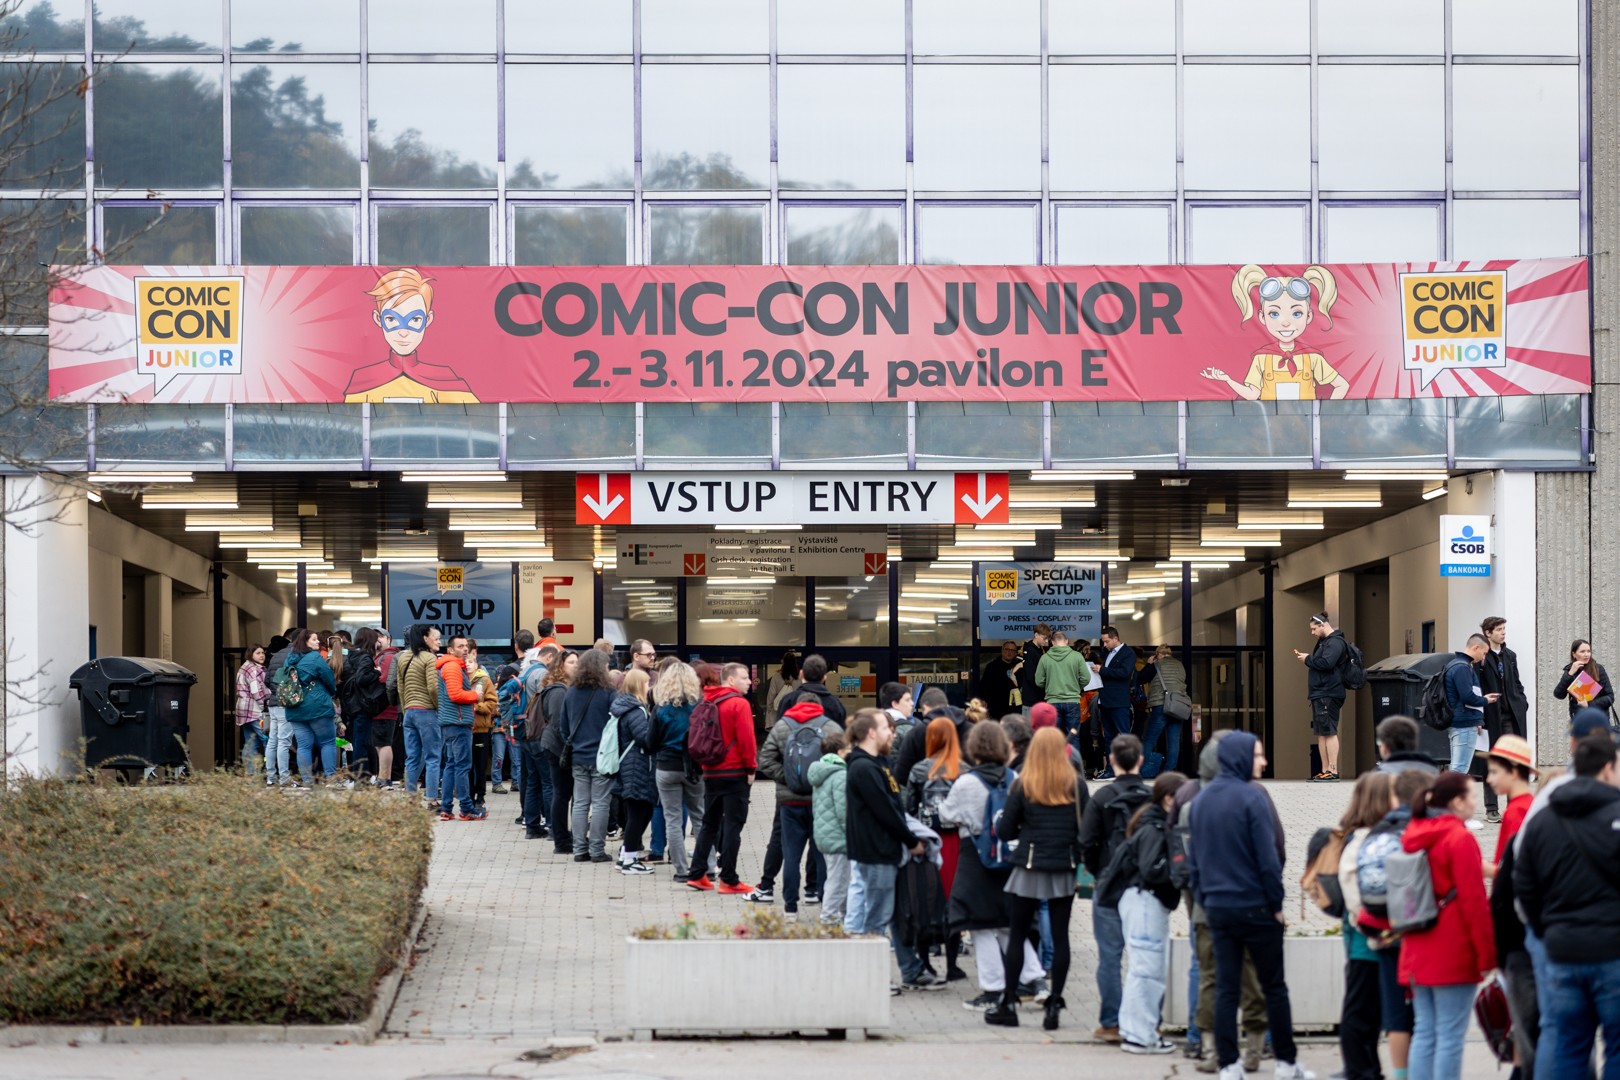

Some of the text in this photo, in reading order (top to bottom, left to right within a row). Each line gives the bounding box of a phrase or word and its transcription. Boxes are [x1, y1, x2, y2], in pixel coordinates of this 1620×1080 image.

[147, 286, 230, 306] COMIC
[1412, 280, 1494, 302] COMIC
[494, 281, 1183, 337] COMIC-CON JUNIOR
[147, 309, 231, 339] CON
[1413, 304, 1495, 334] CON
[145, 349, 234, 368] JUNIOR
[1411, 343, 1498, 364] JUNIOR
[887, 347, 1063, 398] pavilon
[1081, 349, 1108, 387] E
[647, 481, 937, 513] VSTUP ENTRY
[710, 537, 782, 546] Pokladny, registrace
[798, 536, 838, 545] Výstaviště
[1450, 543, 1485, 554] ČSOB
[750, 556, 792, 564] registration
[790, 564, 795, 572] E
[1024, 566, 1096, 581] SPECIÁLNÍ
[1447, 566, 1487, 574] BANKOMAT
[440, 574, 461, 583] CON
[988, 580, 1015, 590] CON
[1037, 584, 1083, 595] VSTUP
[407, 598, 495, 620] VSTUP
[543, 576, 574, 634] E
[1028, 598, 1091, 606] SPECIAL ENTRY
[431, 623, 475, 636] NTRY
